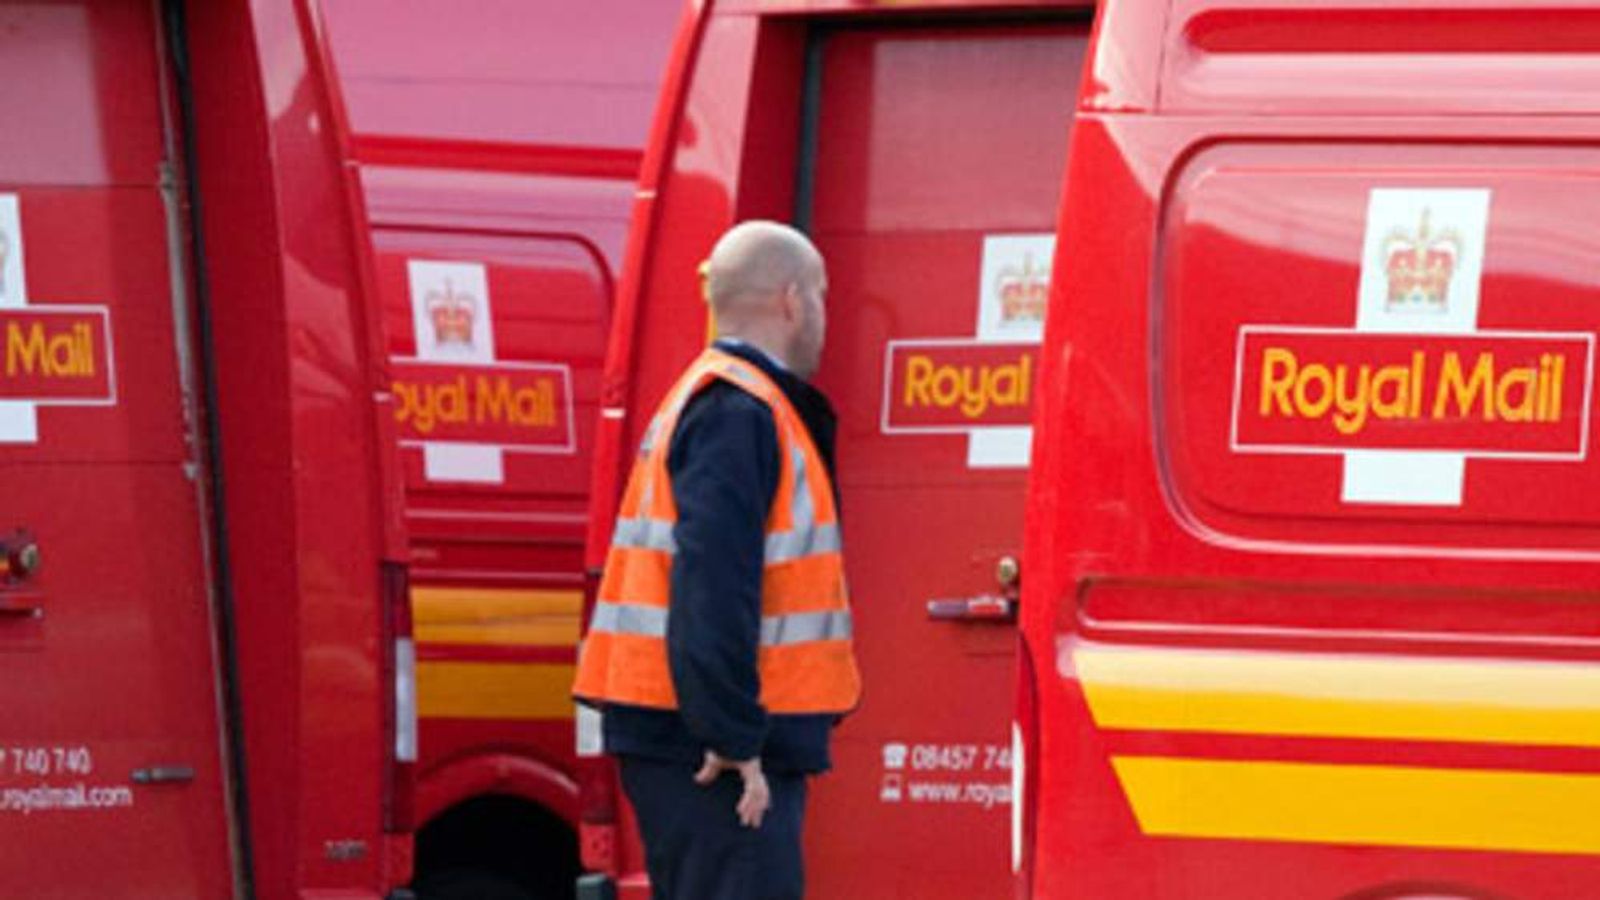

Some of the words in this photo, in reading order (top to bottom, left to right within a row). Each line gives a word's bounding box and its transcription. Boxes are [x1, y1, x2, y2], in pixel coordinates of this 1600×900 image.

[6, 321, 95, 377] Mail
[391, 374, 469, 433] oyal
[475, 375, 556, 427] Mail
[904, 354, 1031, 418] Royal
[1259, 347, 1425, 434] Royal
[1432, 351, 1566, 422] Mail
[911, 744, 978, 770] 08457
[983, 744, 1012, 770] 74
